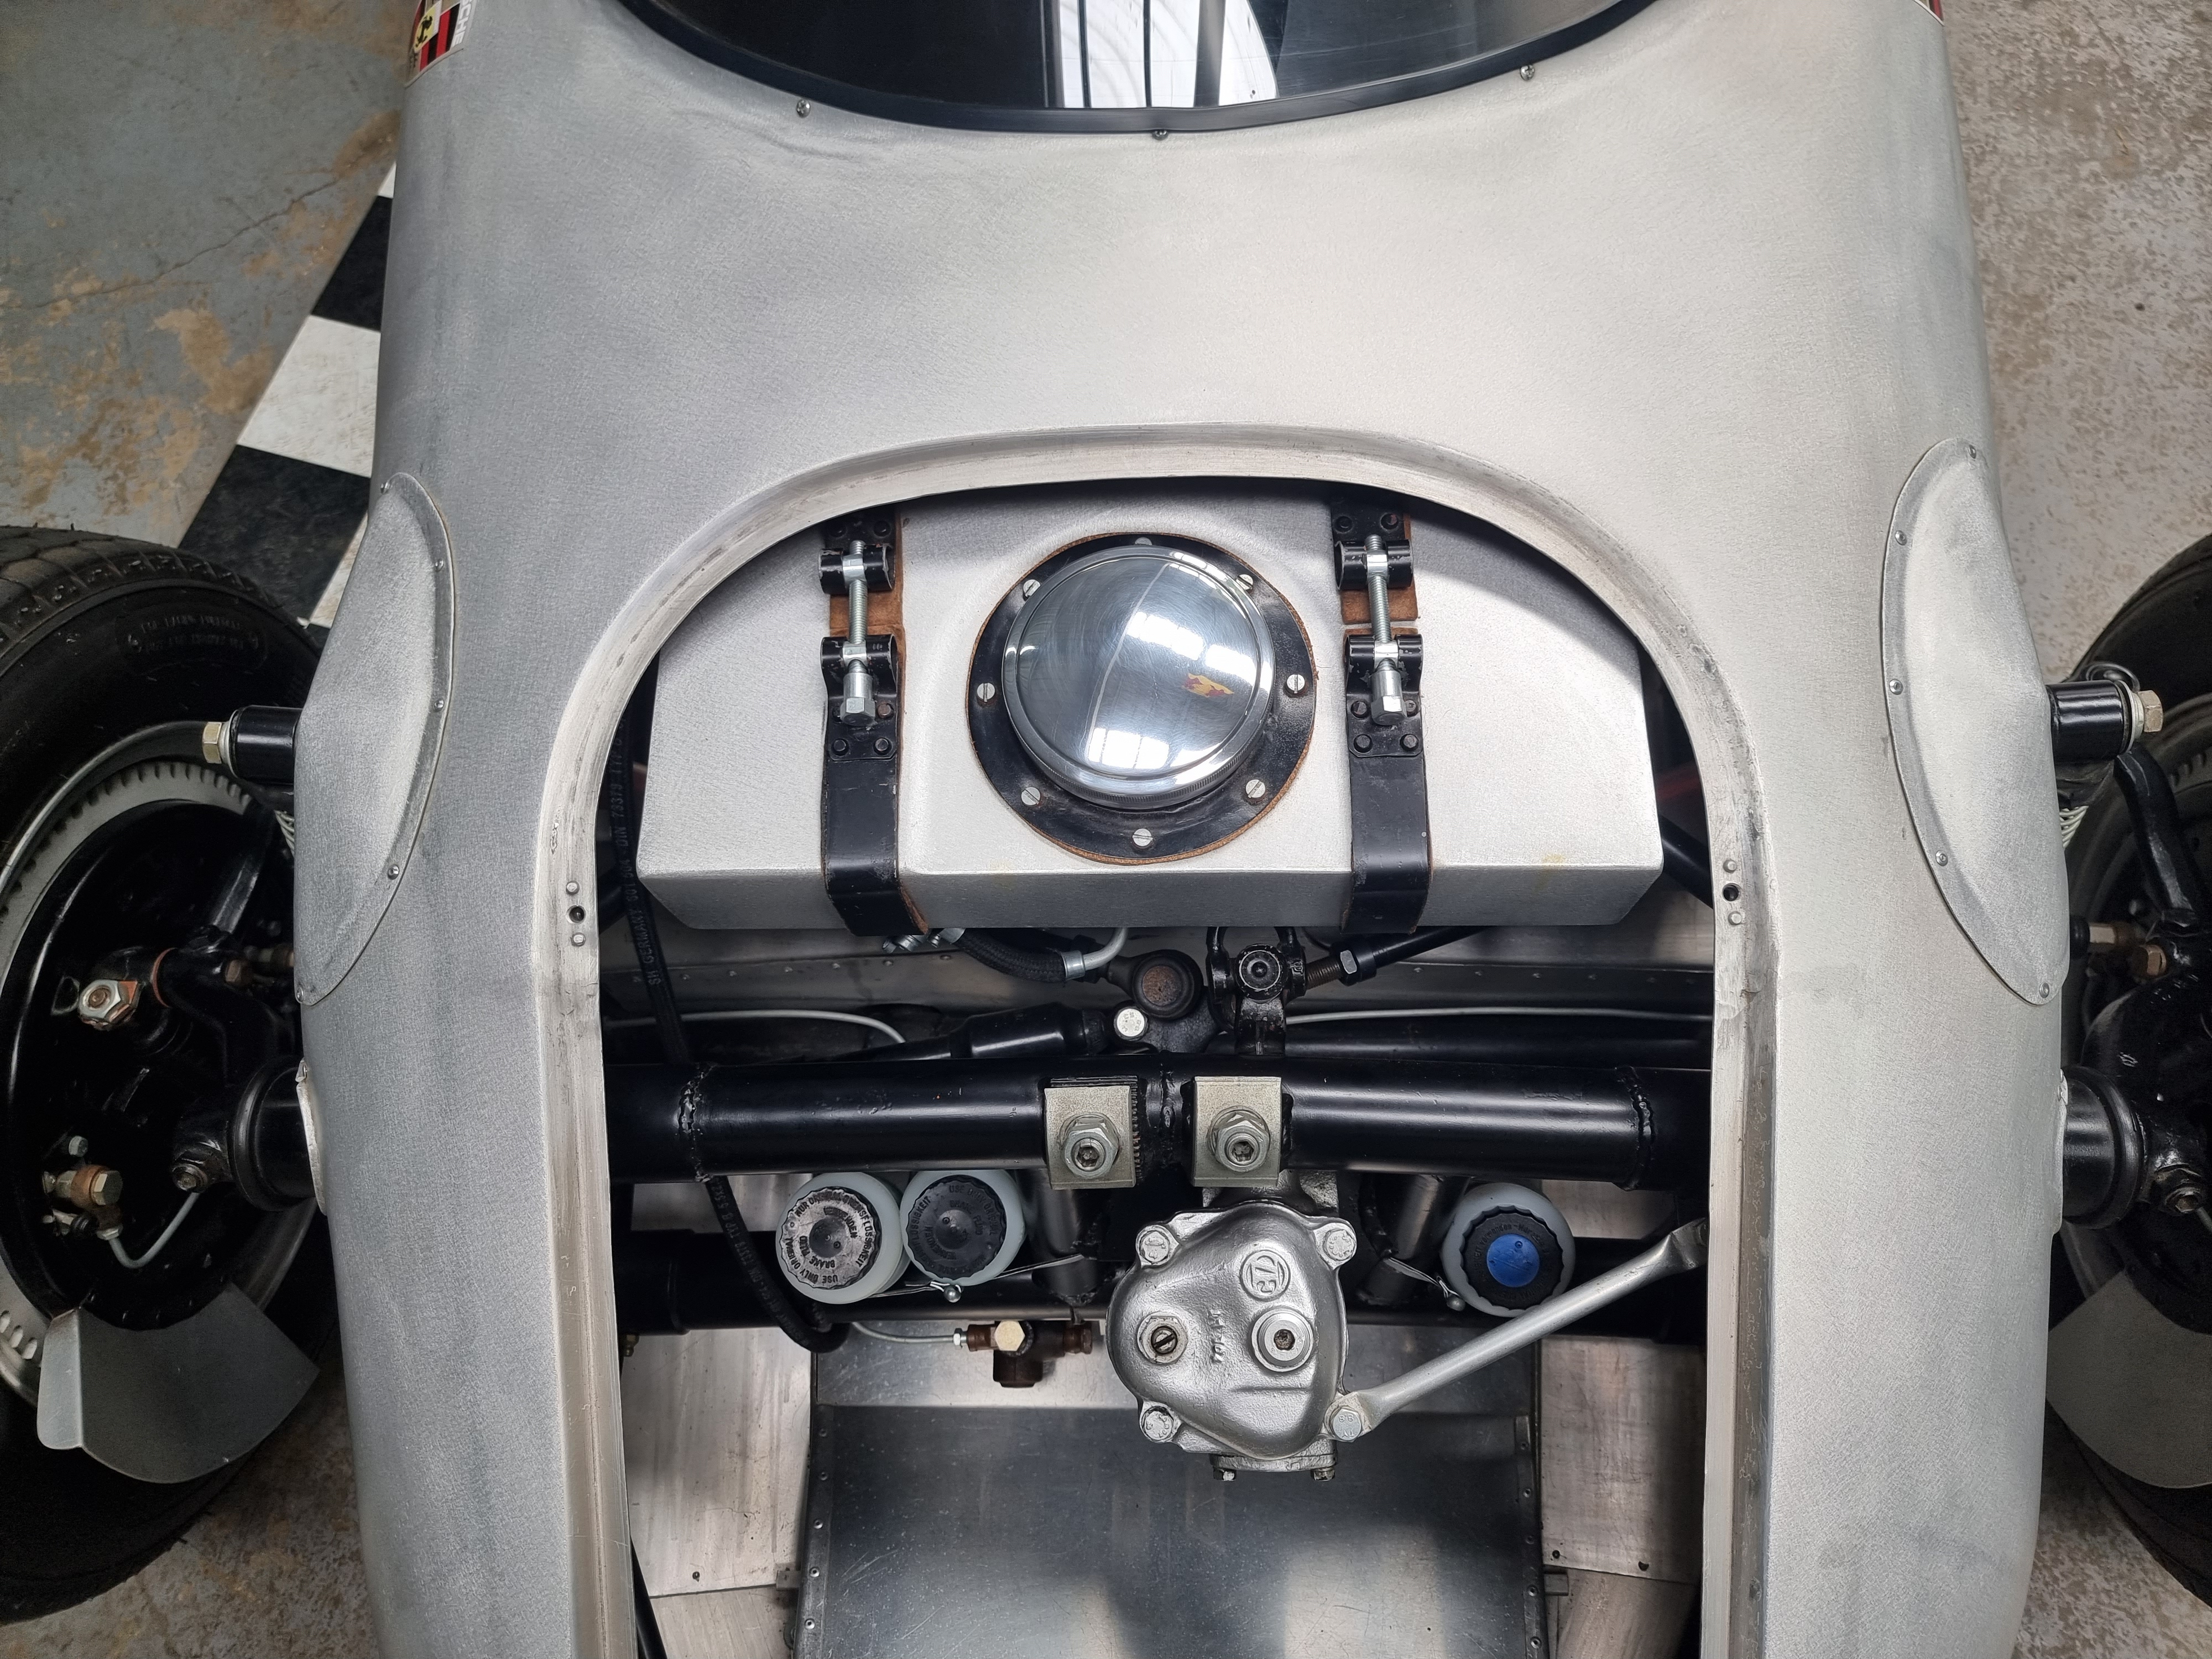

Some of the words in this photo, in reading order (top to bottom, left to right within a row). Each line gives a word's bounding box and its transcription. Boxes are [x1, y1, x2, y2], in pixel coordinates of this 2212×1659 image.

[614, 826, 628, 847] DIN
[629, 907, 655, 964] GERMANY
[948, 1185, 965, 1193] USE
[794, 1201, 810, 1217] NUR
[808, 1255, 836, 1270] BRAKE
[799, 1268, 819, 1284] ONLY
[821, 1274, 838, 1284] USE
